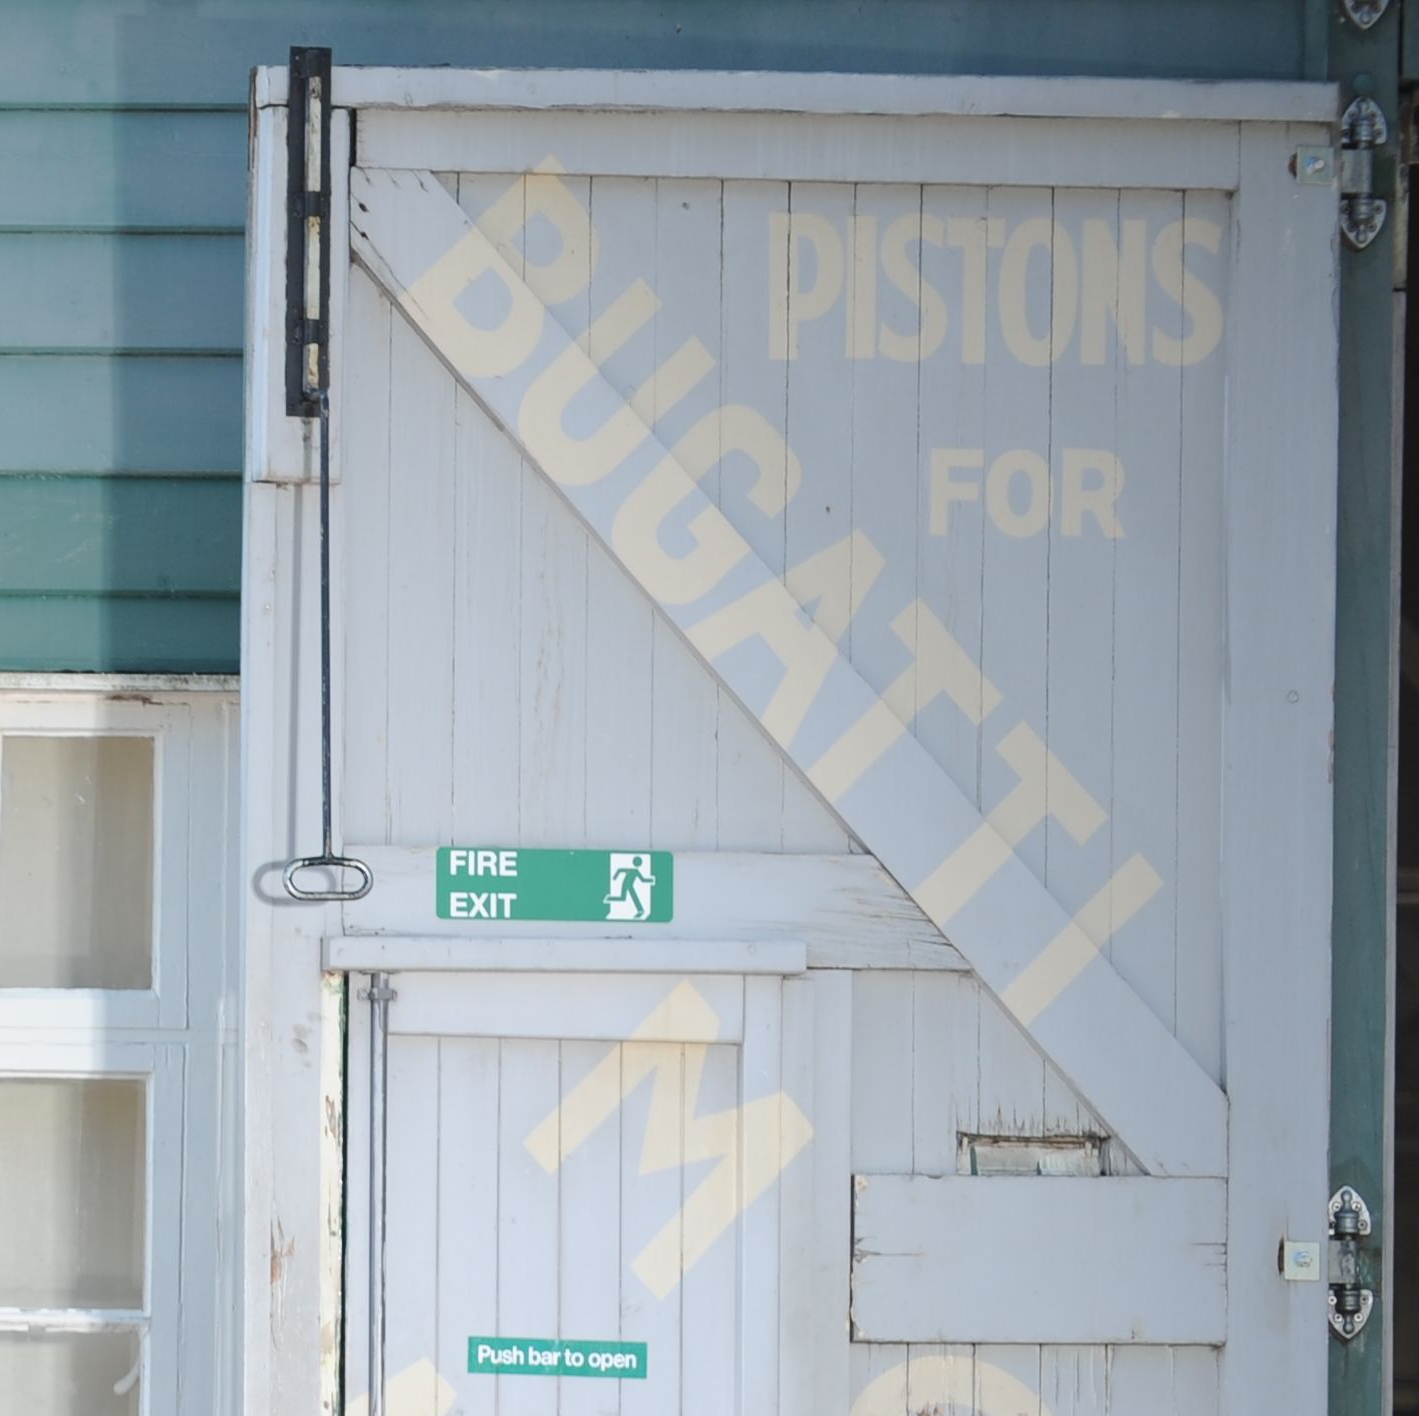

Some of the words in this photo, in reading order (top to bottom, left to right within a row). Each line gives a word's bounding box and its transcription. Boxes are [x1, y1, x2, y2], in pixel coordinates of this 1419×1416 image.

[767, 207, 1225, 368] PISTONS
[928, 448, 1126, 539] FOR
[403, 154, 1163, 1031] BUGATTI
[449, 849, 518, 876] FIRE
[449, 891, 517, 918] EXIT
[522, 979, 815, 1300] M
[477, 1344, 524, 1365] Push
[528, 1346, 561, 1366] bar
[564, 1348, 584, 1367] to
[588, 1351, 636, 1372] open
